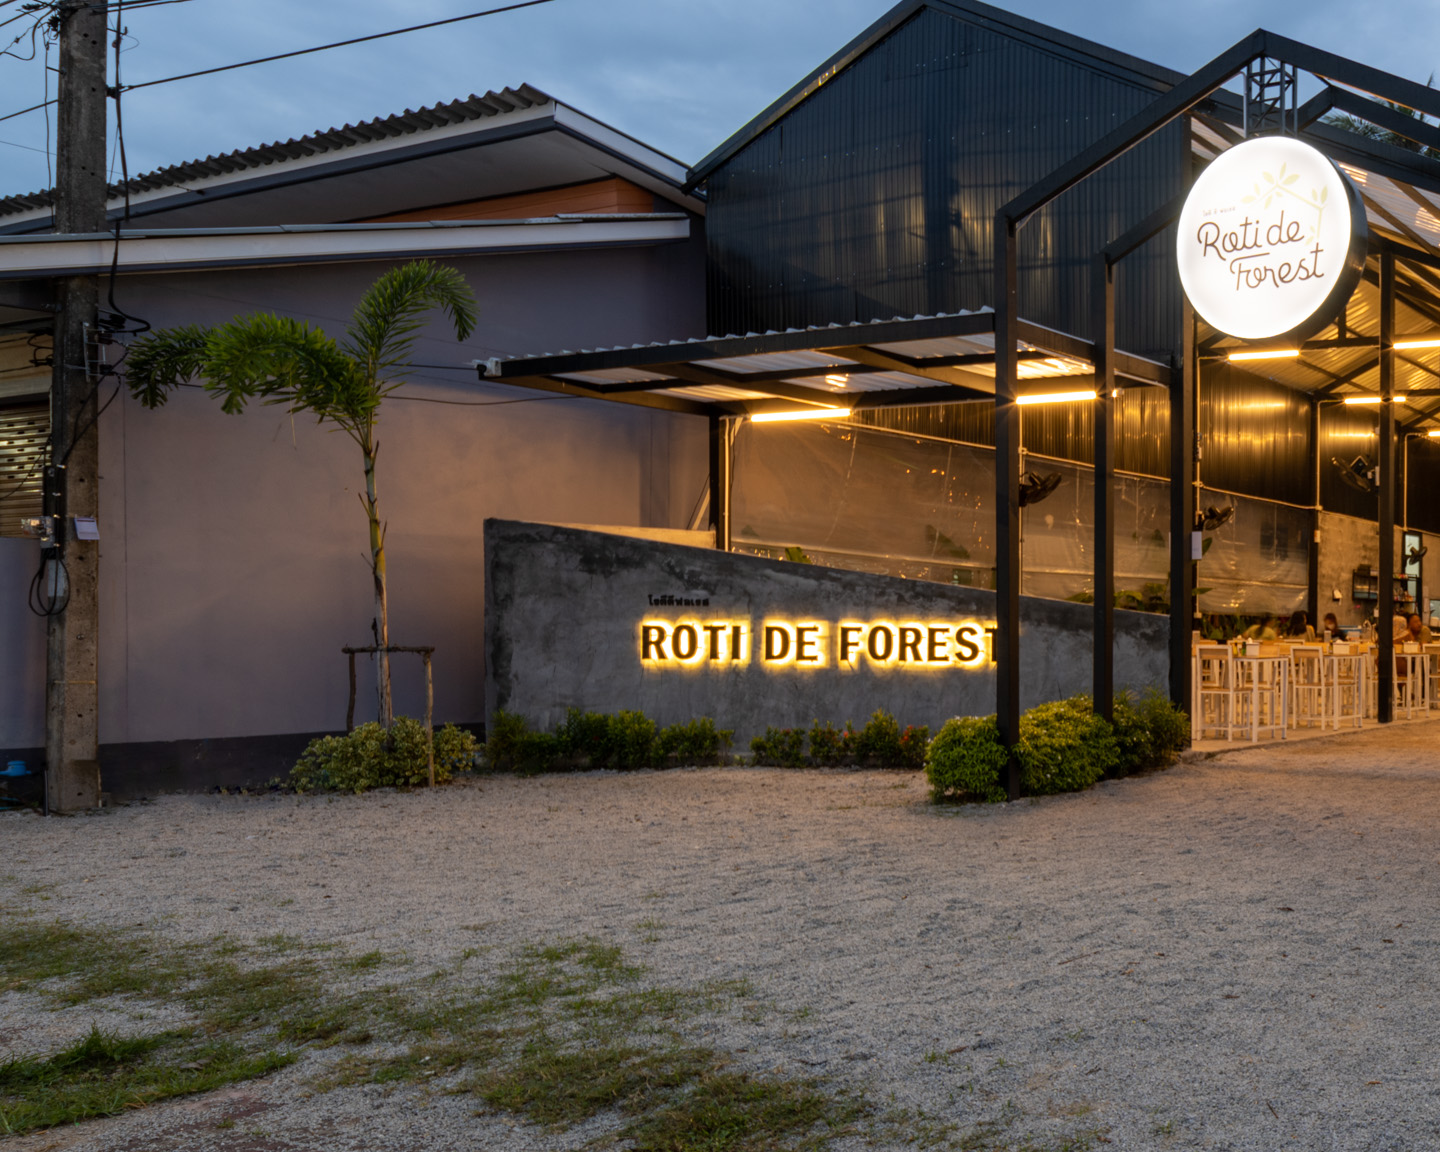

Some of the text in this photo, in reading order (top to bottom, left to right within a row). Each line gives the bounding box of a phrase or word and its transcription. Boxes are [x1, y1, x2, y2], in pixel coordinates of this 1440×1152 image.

[1197, 210, 1305, 261] Roti de
[1230, 242, 1325, 291] Forest
[641, 625, 998, 663] ROTI DE FOREST
